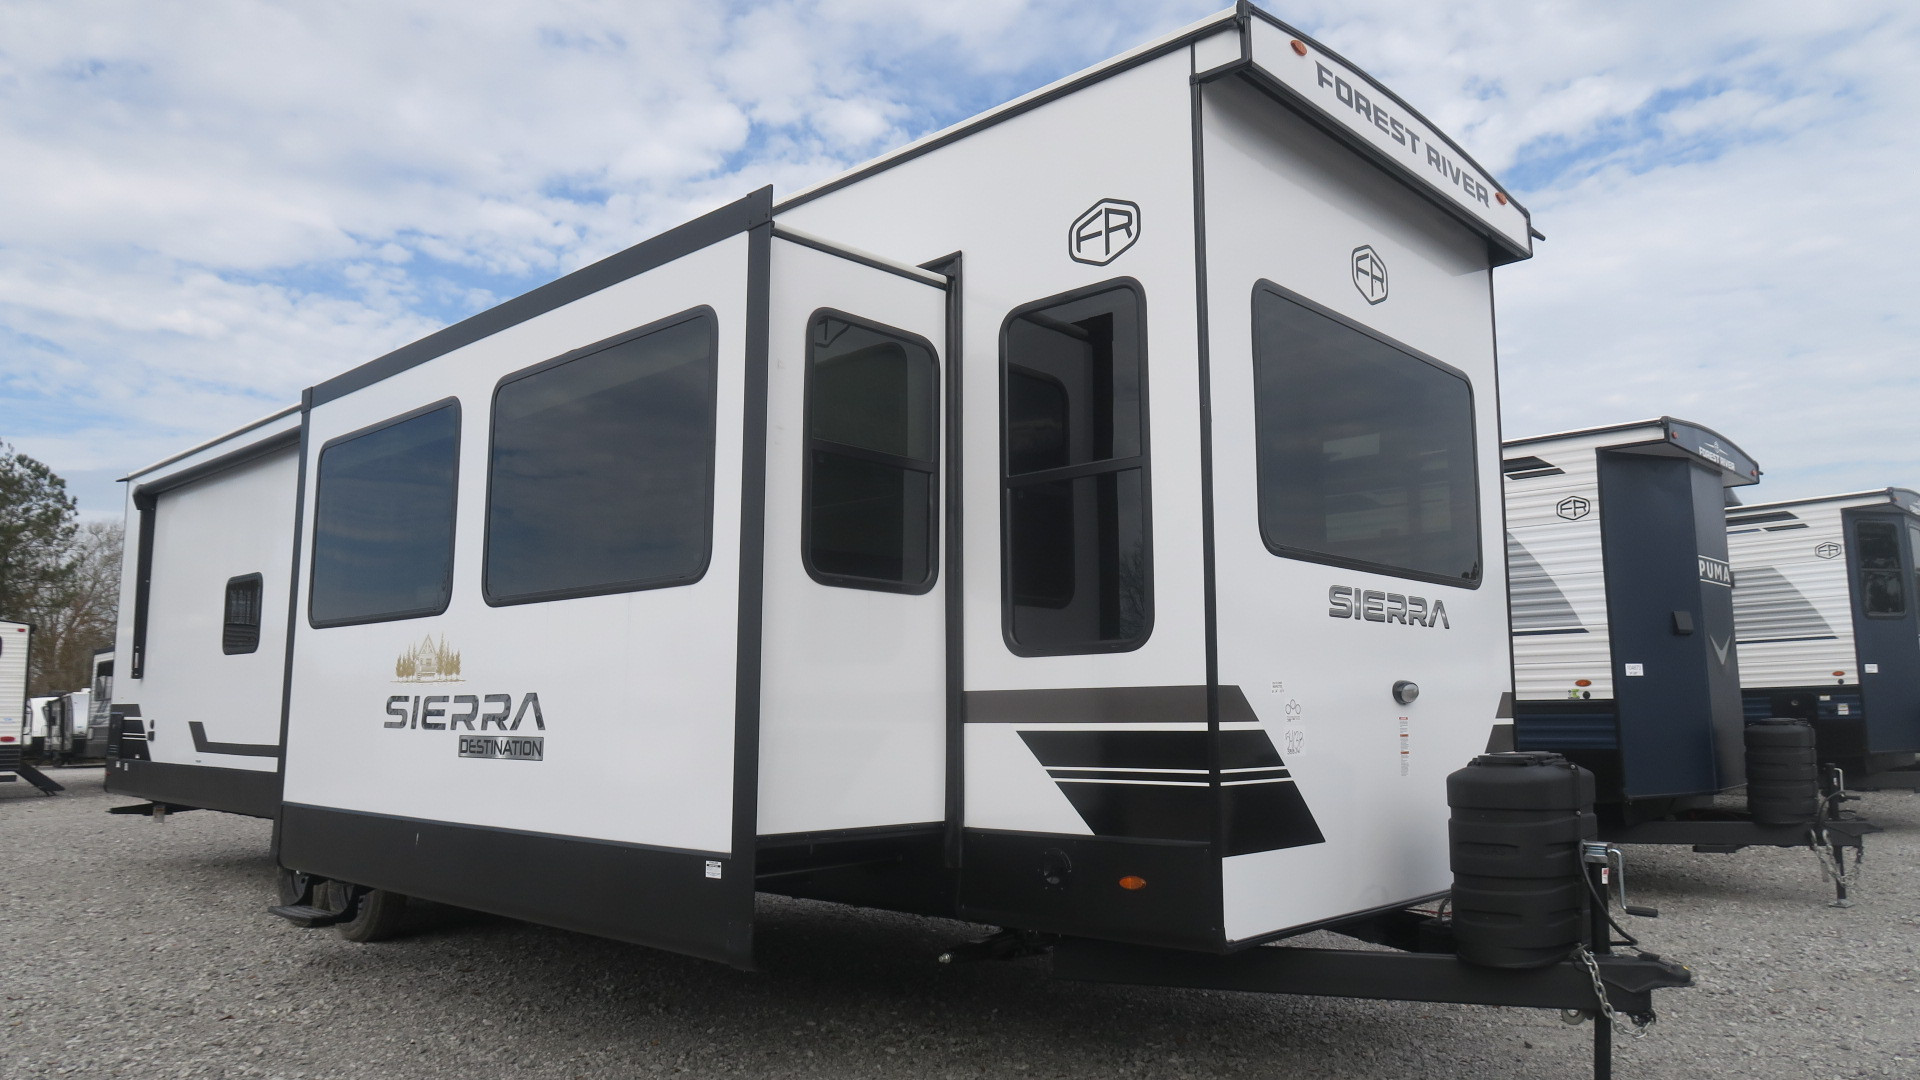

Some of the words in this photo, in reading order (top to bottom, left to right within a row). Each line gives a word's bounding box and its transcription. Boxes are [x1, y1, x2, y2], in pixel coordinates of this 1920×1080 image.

[1315, 61, 1420, 154] FOREST
[1425, 142, 1490, 208] RIVER
[1698, 559, 1731, 583] PUMA
[1328, 584, 1450, 629] SIERRA
[383, 692, 546, 731] SIERRA
[460, 738, 543, 757] DESTINATION
